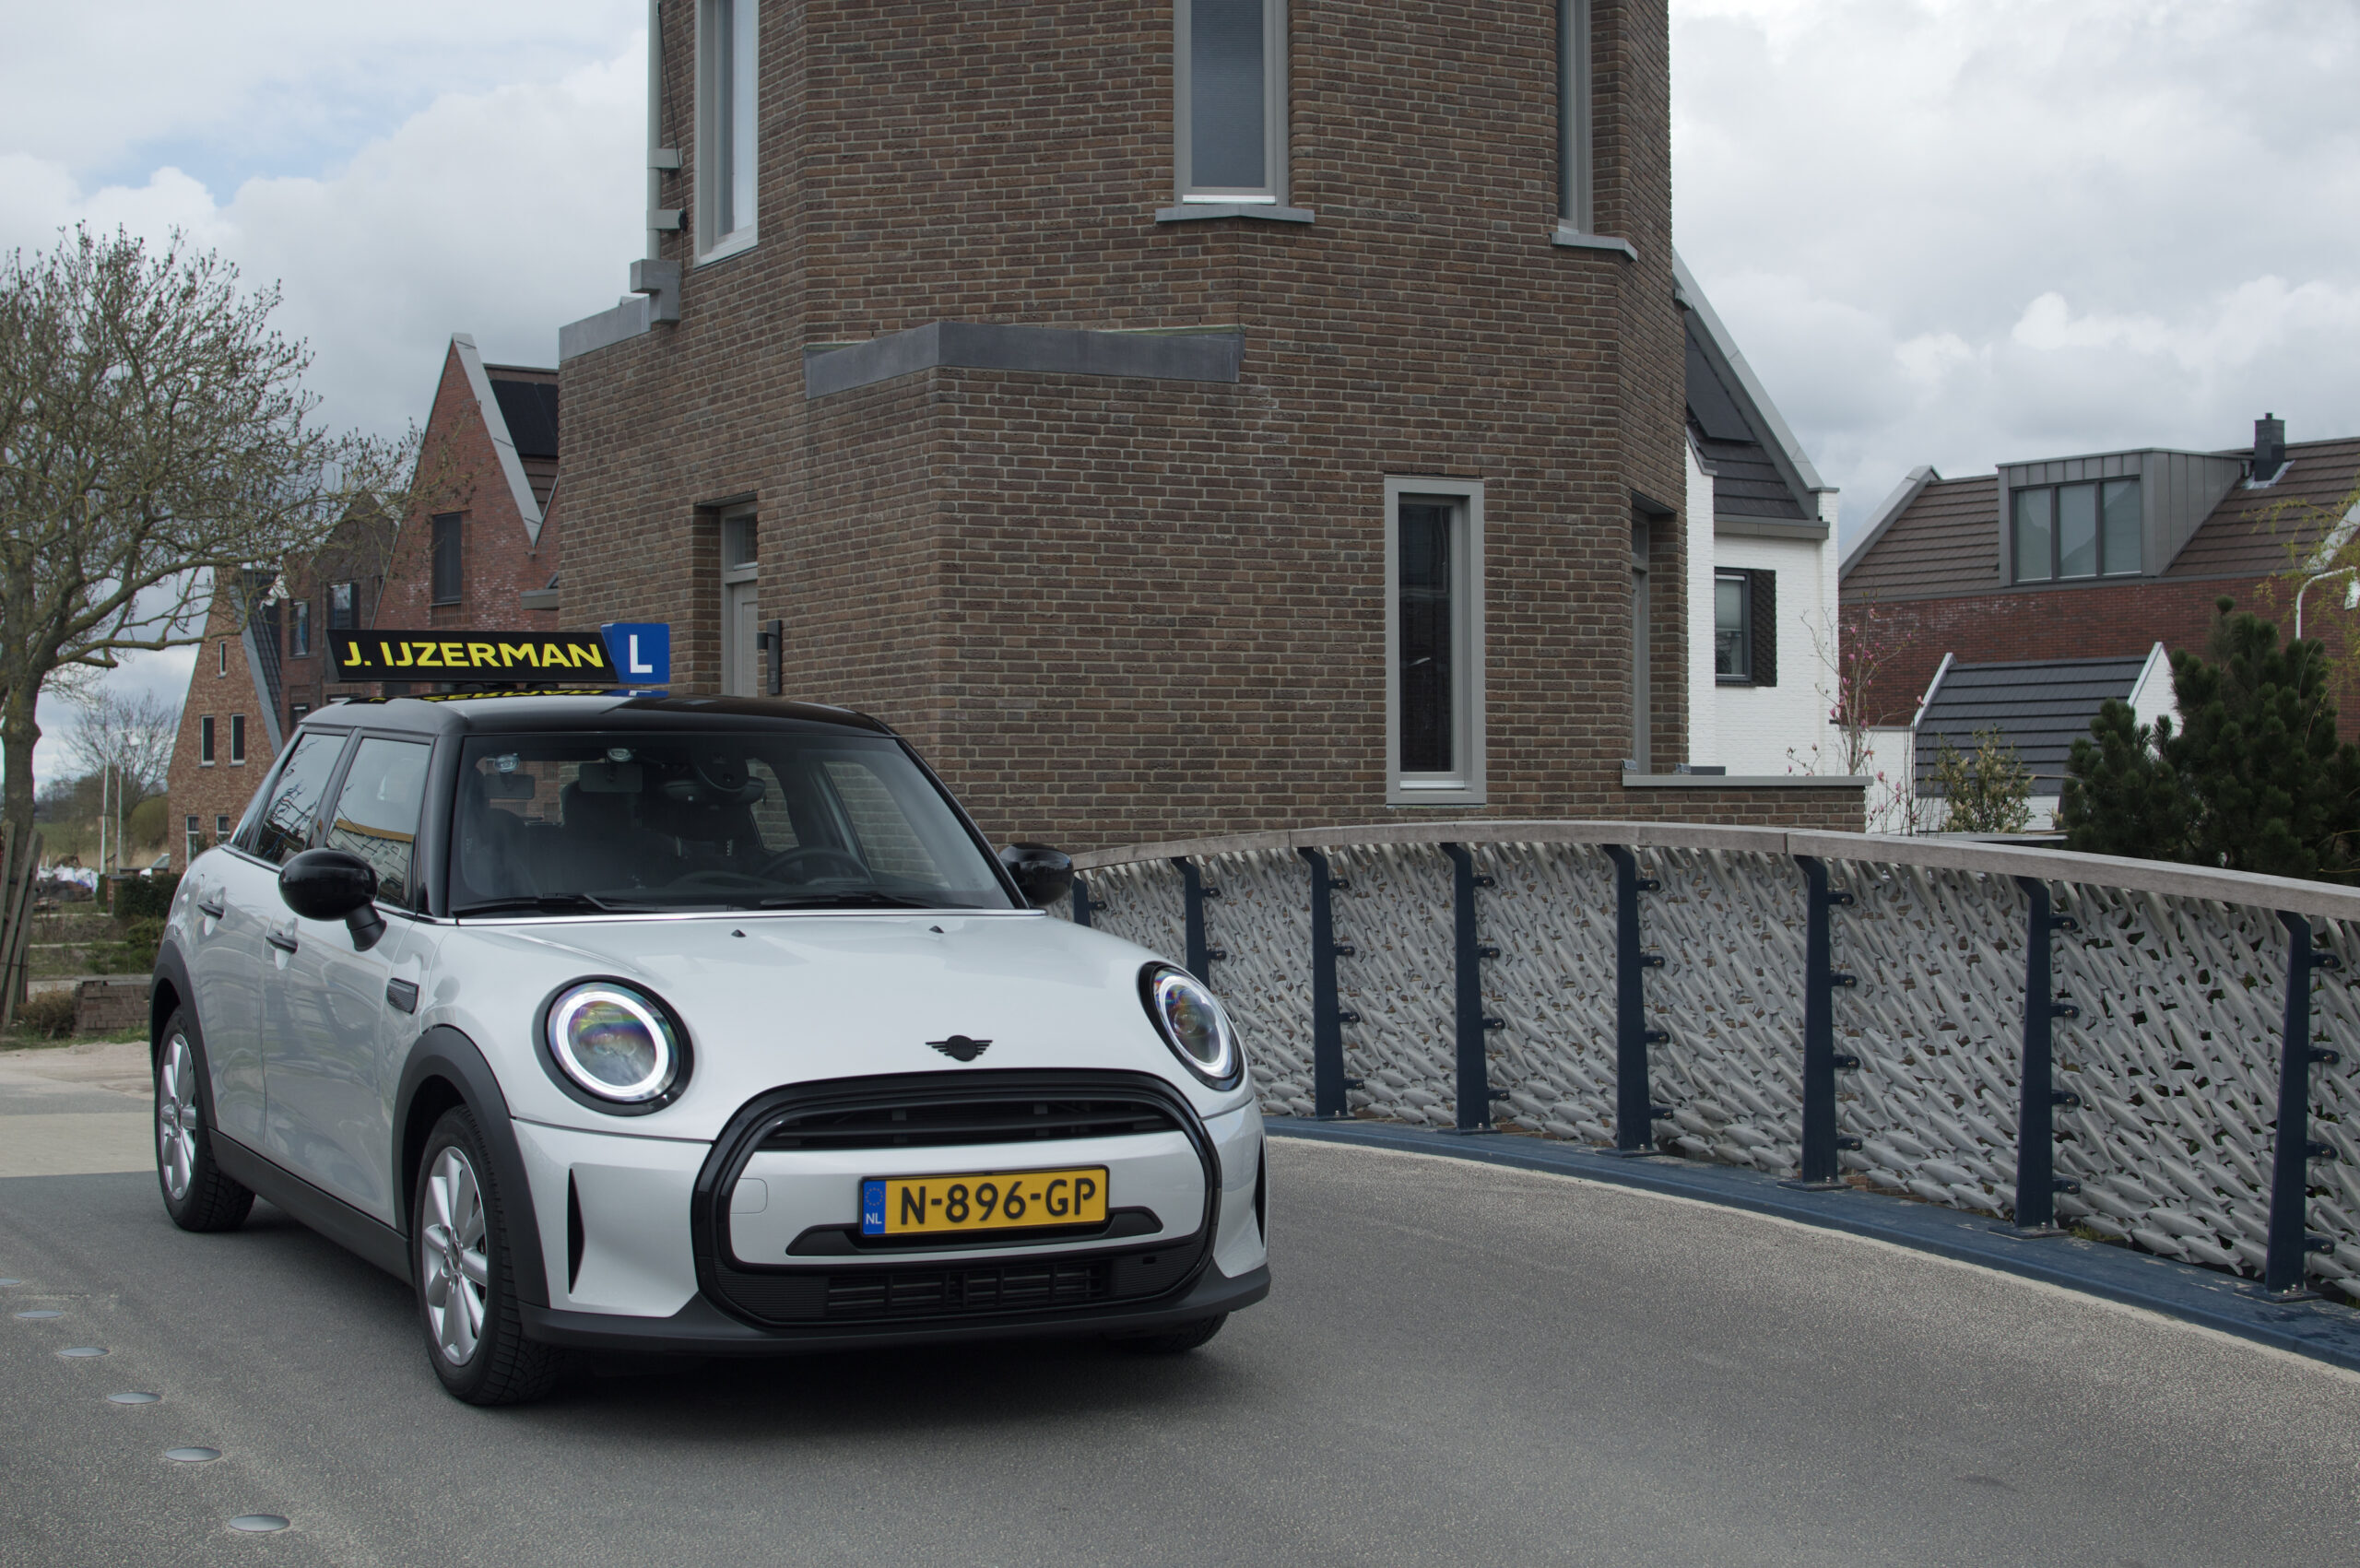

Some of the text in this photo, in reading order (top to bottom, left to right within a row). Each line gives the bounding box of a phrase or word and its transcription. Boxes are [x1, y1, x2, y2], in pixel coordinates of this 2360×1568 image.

[344, 642, 605, 667] J. IJZERMAN
[629, 634, 653, 674] L
[901, 1177, 1096, 1225] N-896-GP
[866, 1212, 882, 1224] NL
